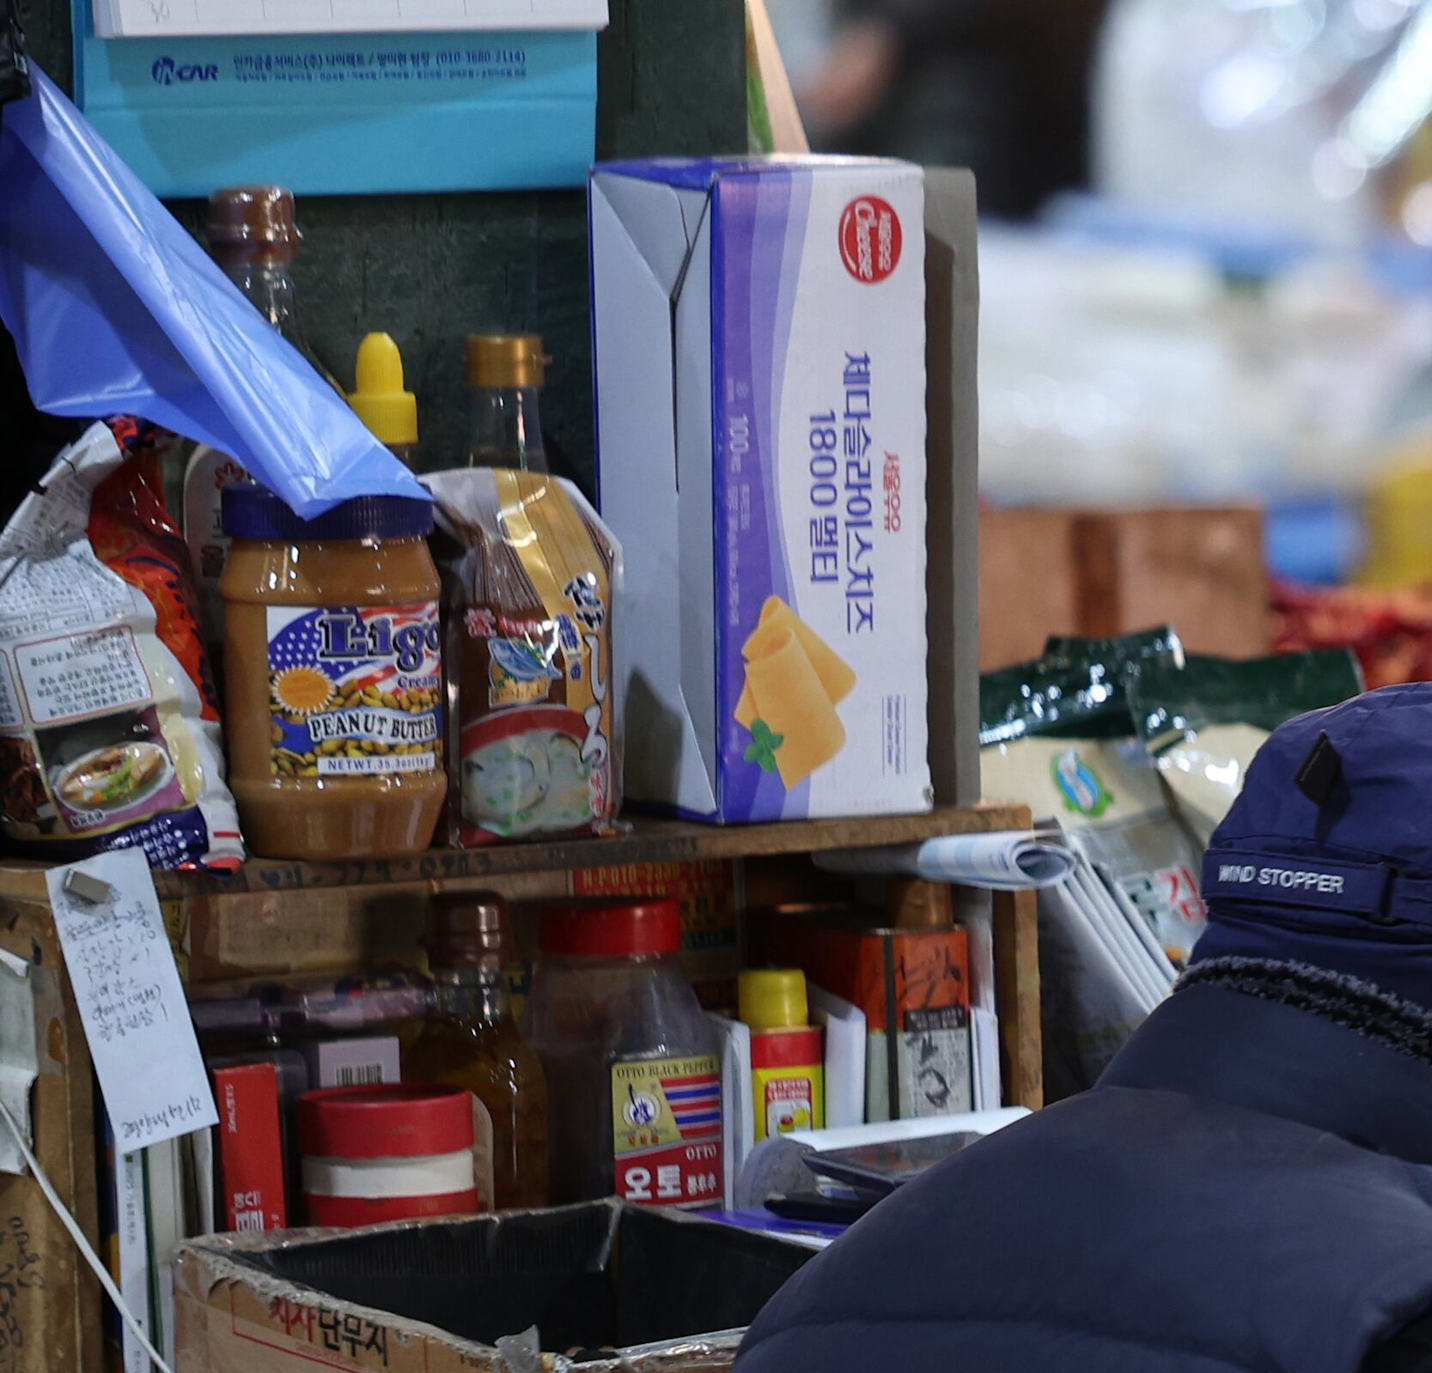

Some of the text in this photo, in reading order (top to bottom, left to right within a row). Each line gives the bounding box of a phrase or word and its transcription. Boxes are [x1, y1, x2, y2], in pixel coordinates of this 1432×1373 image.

[855, 200, 877, 281] Cheese
[809, 409, 839, 585] 1800 멀티
[843, 350, 875, 634] 체다슬라이스치즈
[882, 450, 901, 534] 서울우유
[310, 712, 437, 740] PEANUT BUTTER
[1218, 865, 1345, 894] WIND STOPPER
[616, 1065, 645, 1079] OTTO
[647, 1062, 681, 1077] BLACK
[686, 1143, 717, 1161] OTTO
[624, 1163, 682, 1201] 오토
